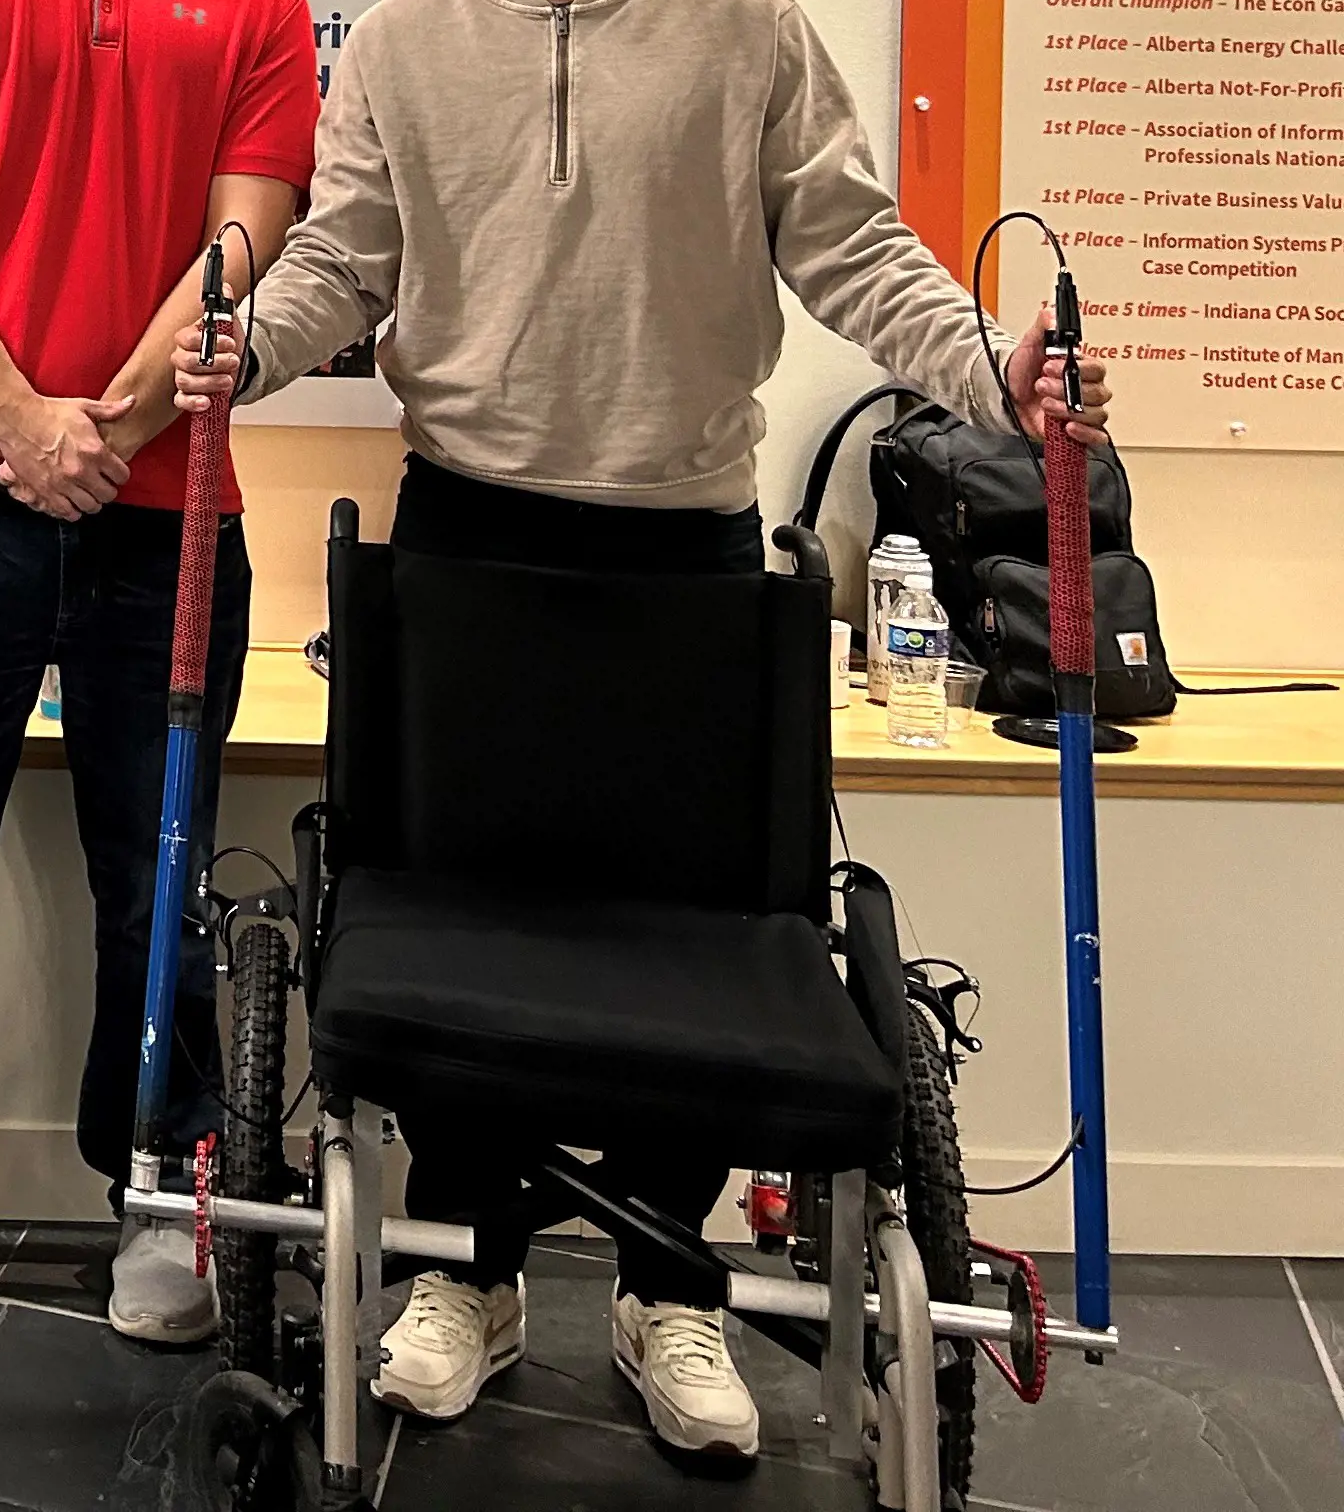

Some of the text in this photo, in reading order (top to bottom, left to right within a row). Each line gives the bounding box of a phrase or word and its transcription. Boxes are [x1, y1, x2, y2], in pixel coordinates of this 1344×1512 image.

[1145, 35, 1286, 59] Alberta Energy
[1144, 147, 1270, 166] Professionals
[1142, 259, 1297, 281] Case Competition
